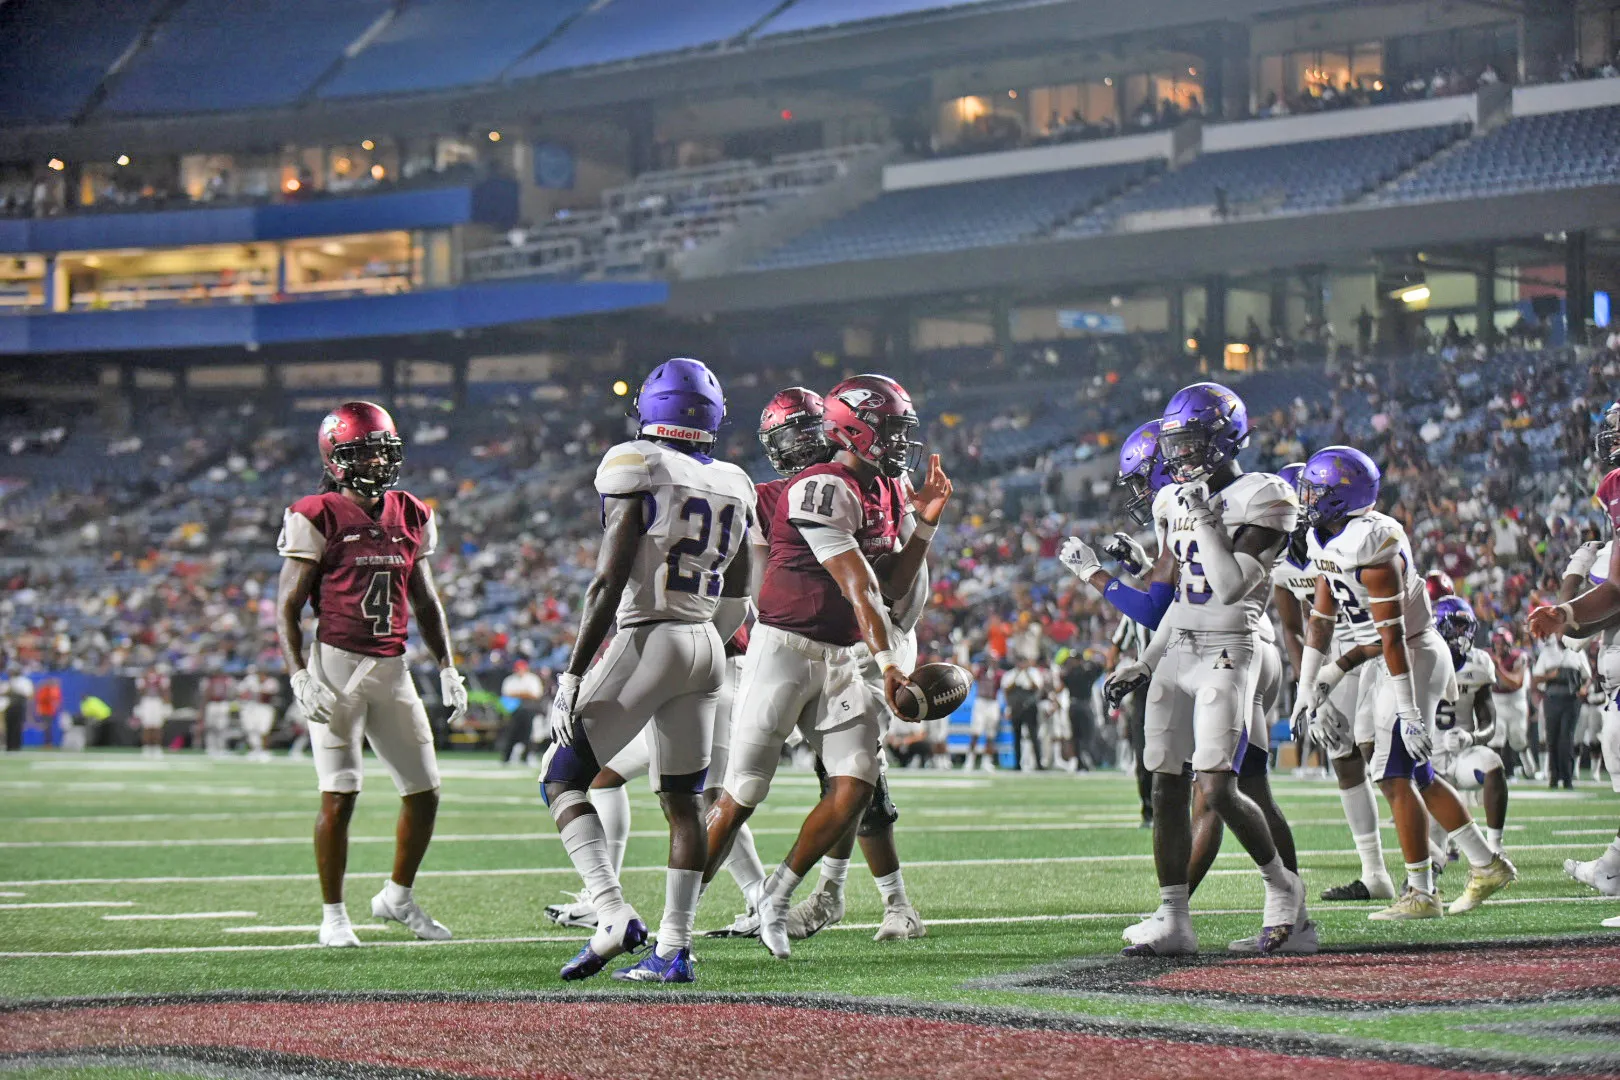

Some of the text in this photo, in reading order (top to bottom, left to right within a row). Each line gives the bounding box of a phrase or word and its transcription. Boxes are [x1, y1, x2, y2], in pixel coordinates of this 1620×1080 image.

[656, 426, 701, 440] Riddell
[801, 480, 836, 517] 11
[665, 496, 736, 597] 21
[361, 571, 393, 635] 4
[841, 700, 850, 712] 5
